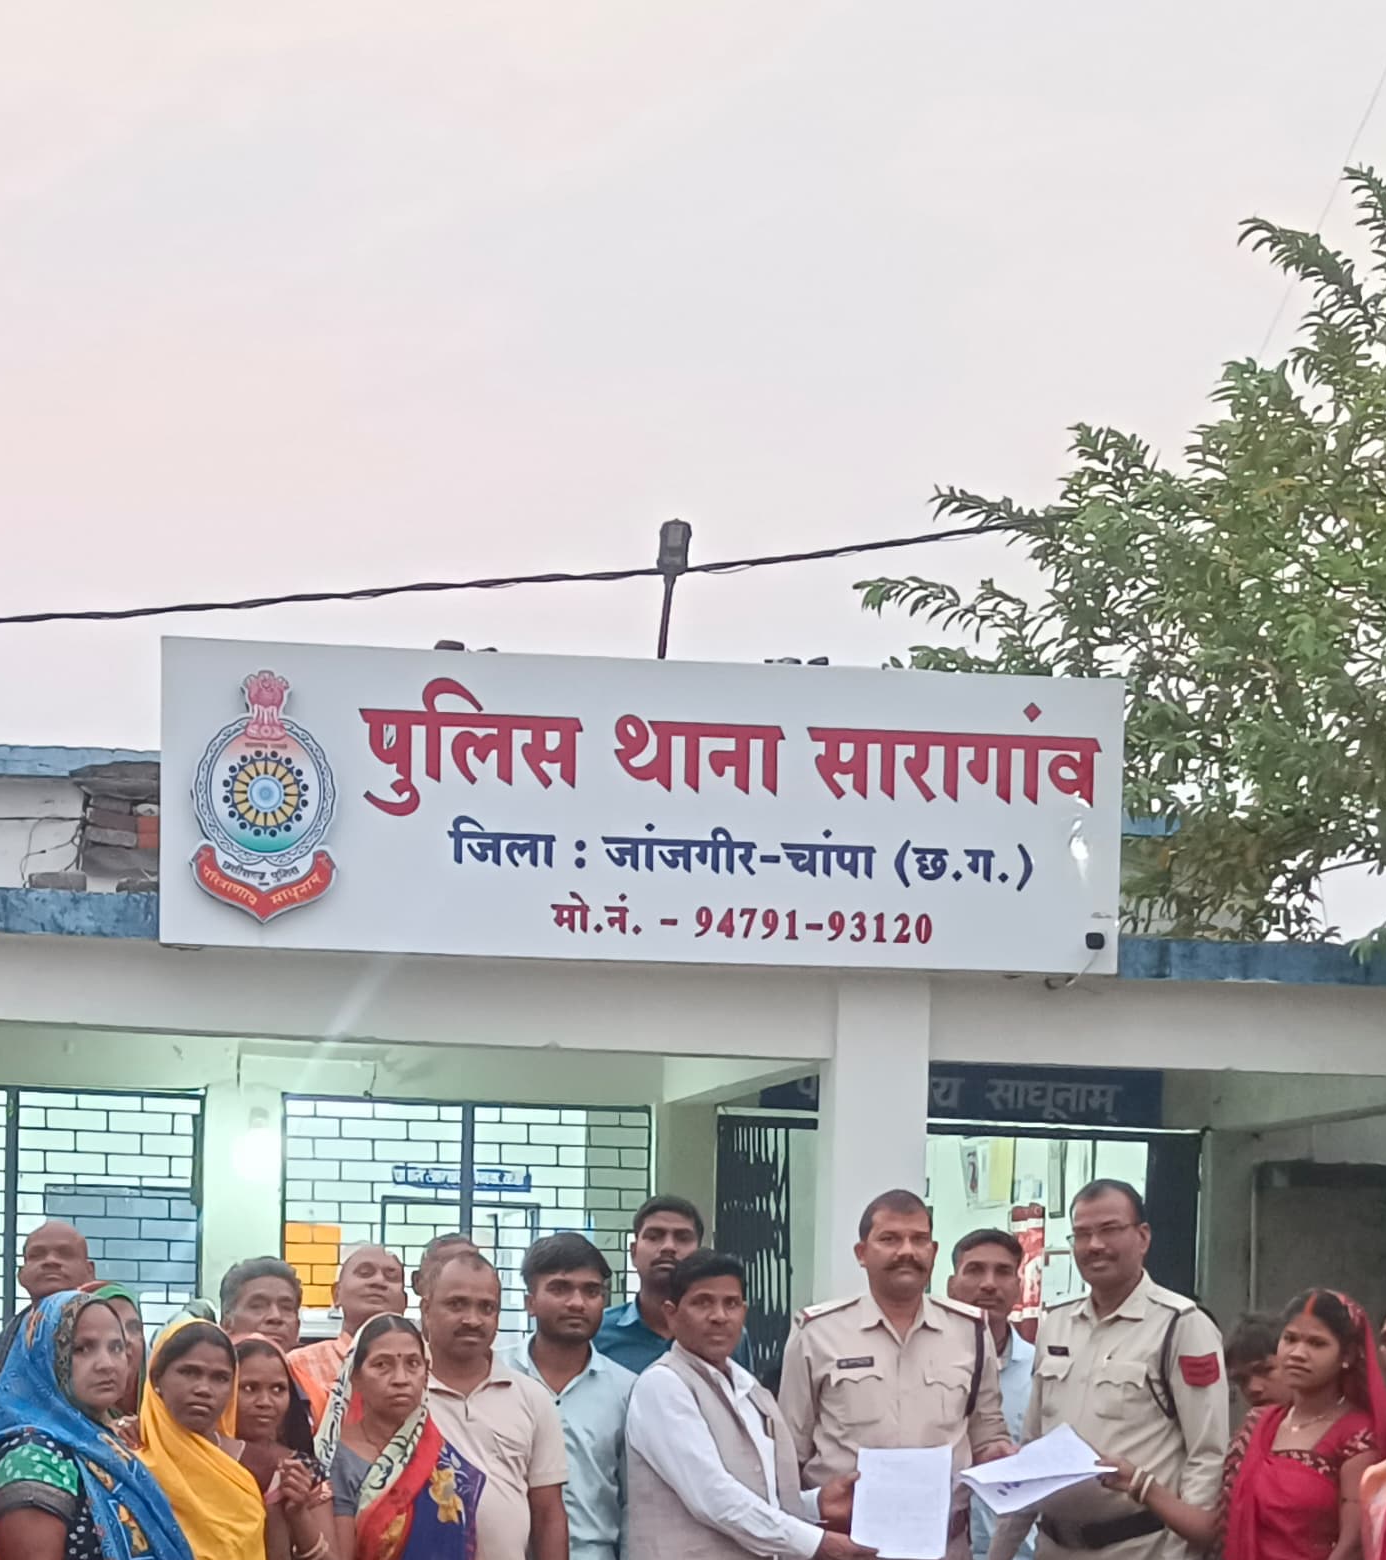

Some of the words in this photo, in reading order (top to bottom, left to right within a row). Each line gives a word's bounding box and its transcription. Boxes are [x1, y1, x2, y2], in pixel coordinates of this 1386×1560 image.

[360, 678, 583, 817] पुलिस
[615, 713, 785, 796] थाना
[808, 701, 1102, 806] सारागांव
[447, 815, 556, 868] जिला
[601, 823, 876, 880] जांजगीर-चांपा
[893, 840, 1035, 892] (छ.ग.)
[550, 891, 643, 936] मो.नं.
[694, 905, 934, 945] 94791-93120
